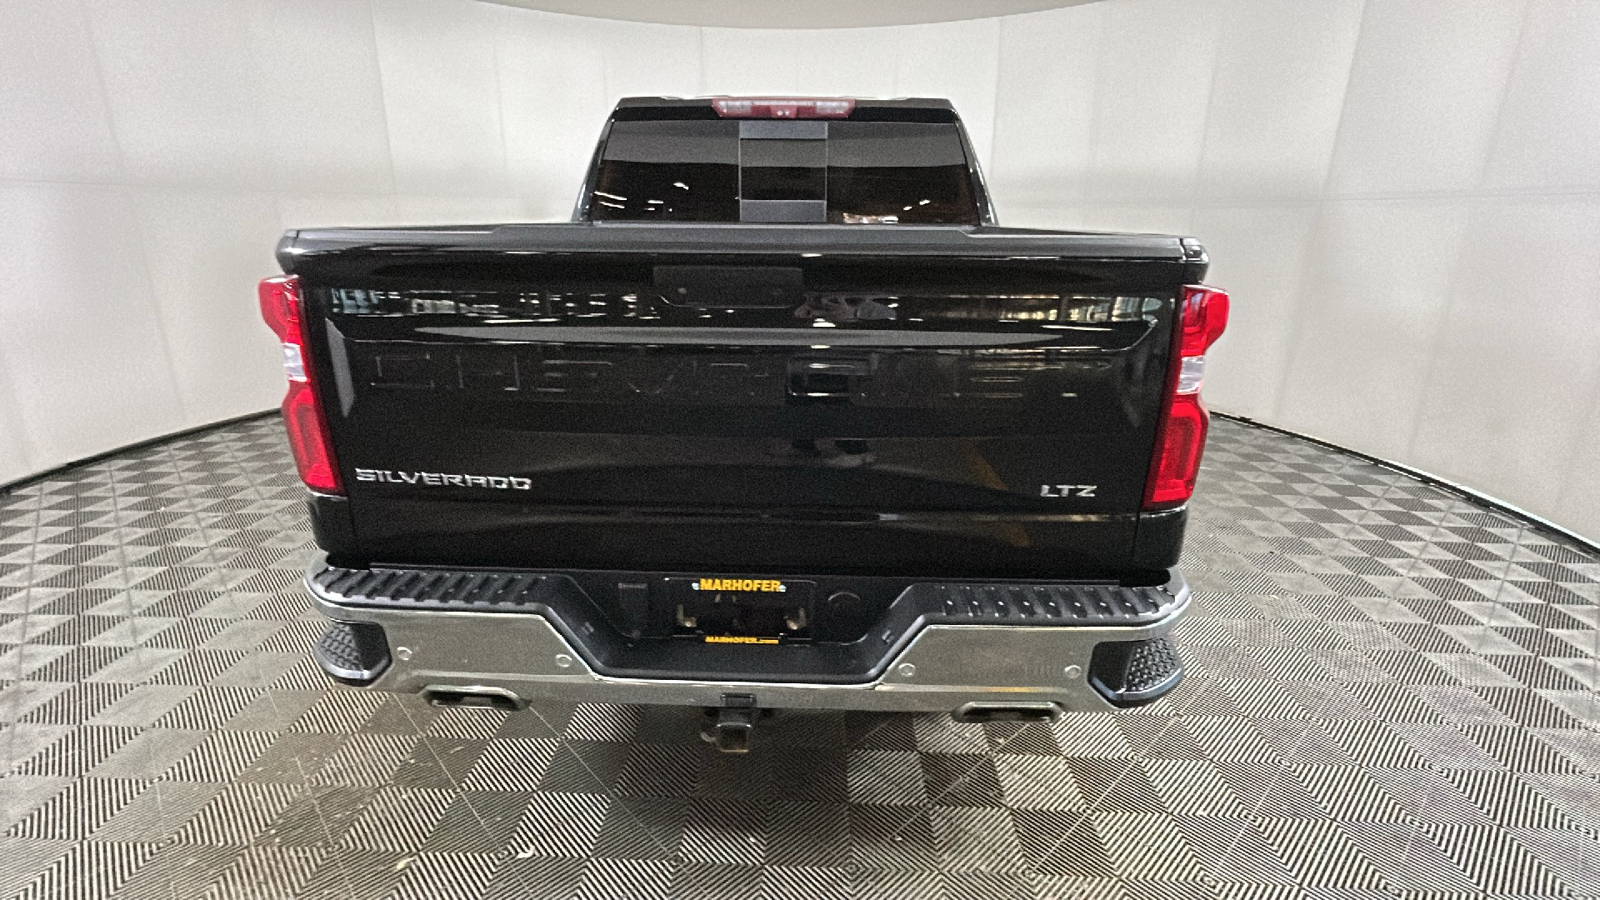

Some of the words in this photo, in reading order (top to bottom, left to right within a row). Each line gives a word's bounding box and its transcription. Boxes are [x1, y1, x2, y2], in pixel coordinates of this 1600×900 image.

[371, 350, 1112, 398] CHEVOE
[355, 468, 532, 490] SILVERADO
[1040, 484, 1097, 497] LTZ
[700, 578, 781, 592] MARHOFER
